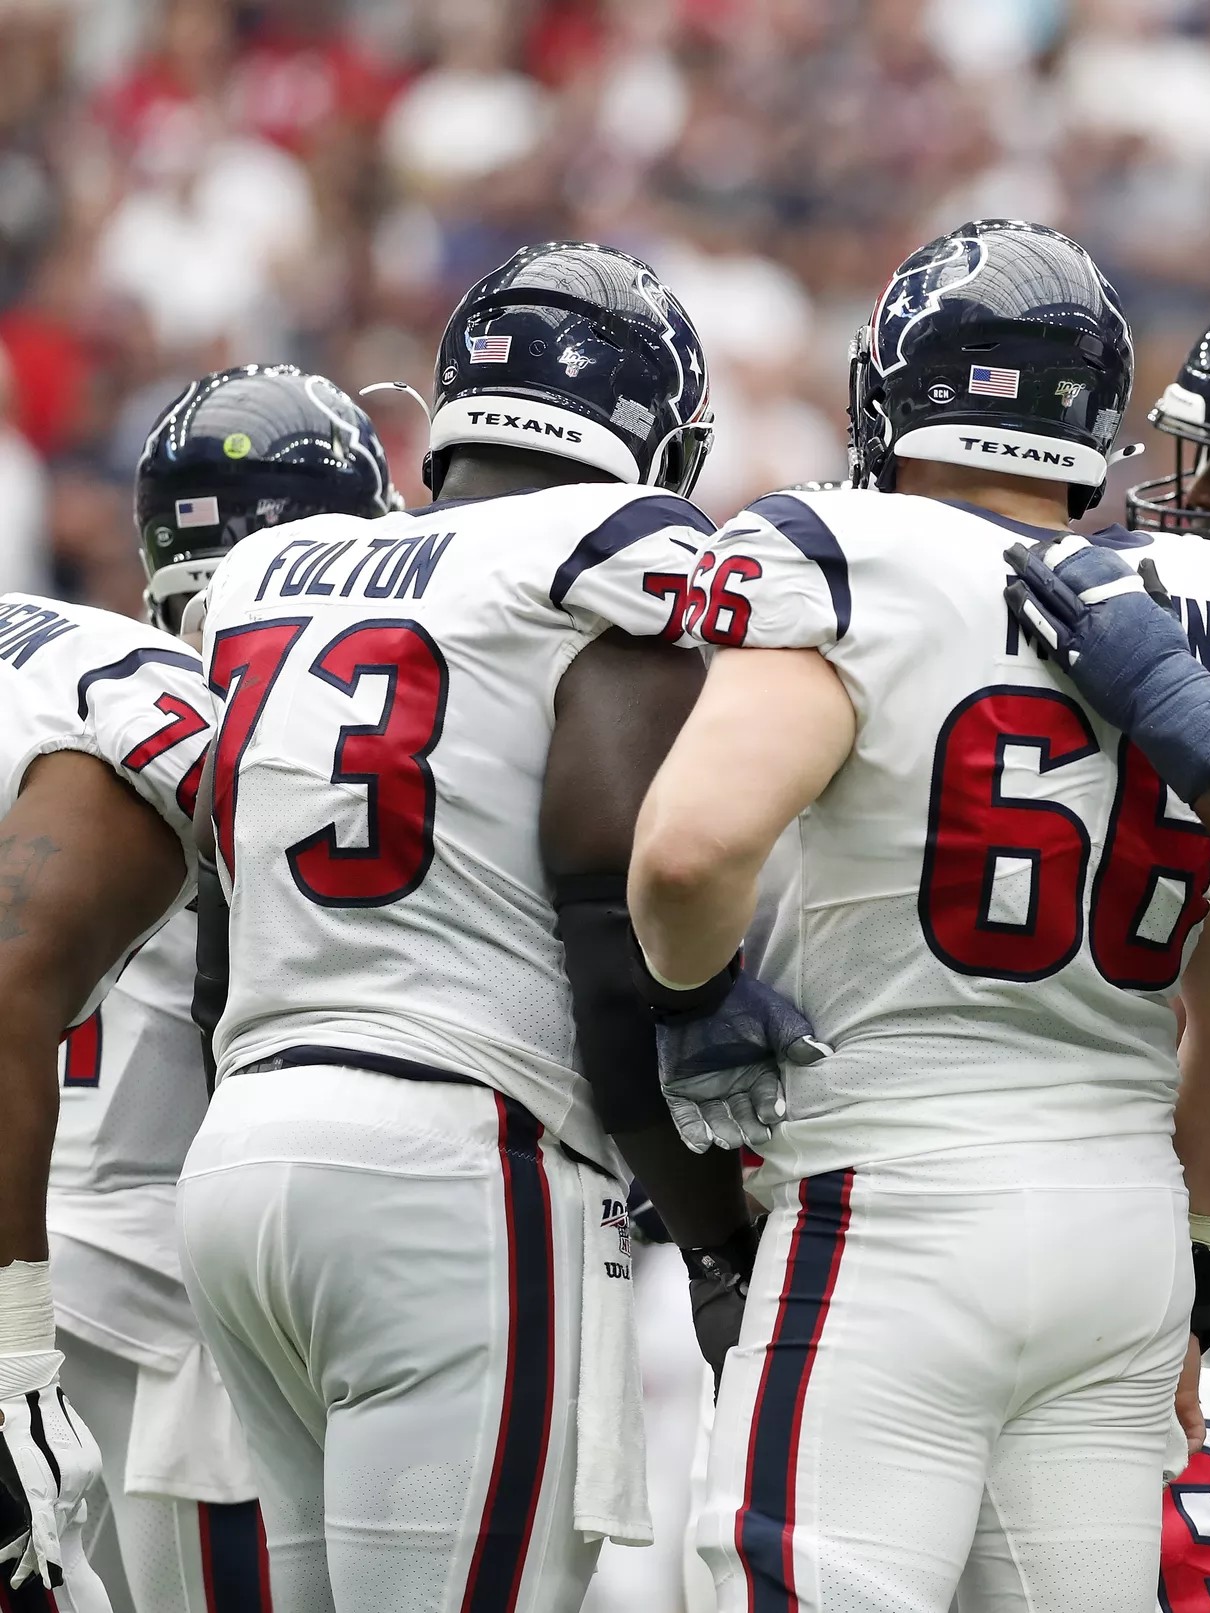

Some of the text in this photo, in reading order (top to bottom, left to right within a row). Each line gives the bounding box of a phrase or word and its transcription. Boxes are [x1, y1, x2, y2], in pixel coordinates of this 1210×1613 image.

[467, 411, 583, 444] TEXANS
[959, 436, 1076, 468] TEXANS
[255, 532, 456, 601] FULTON
[209, 615, 449, 908] 73
